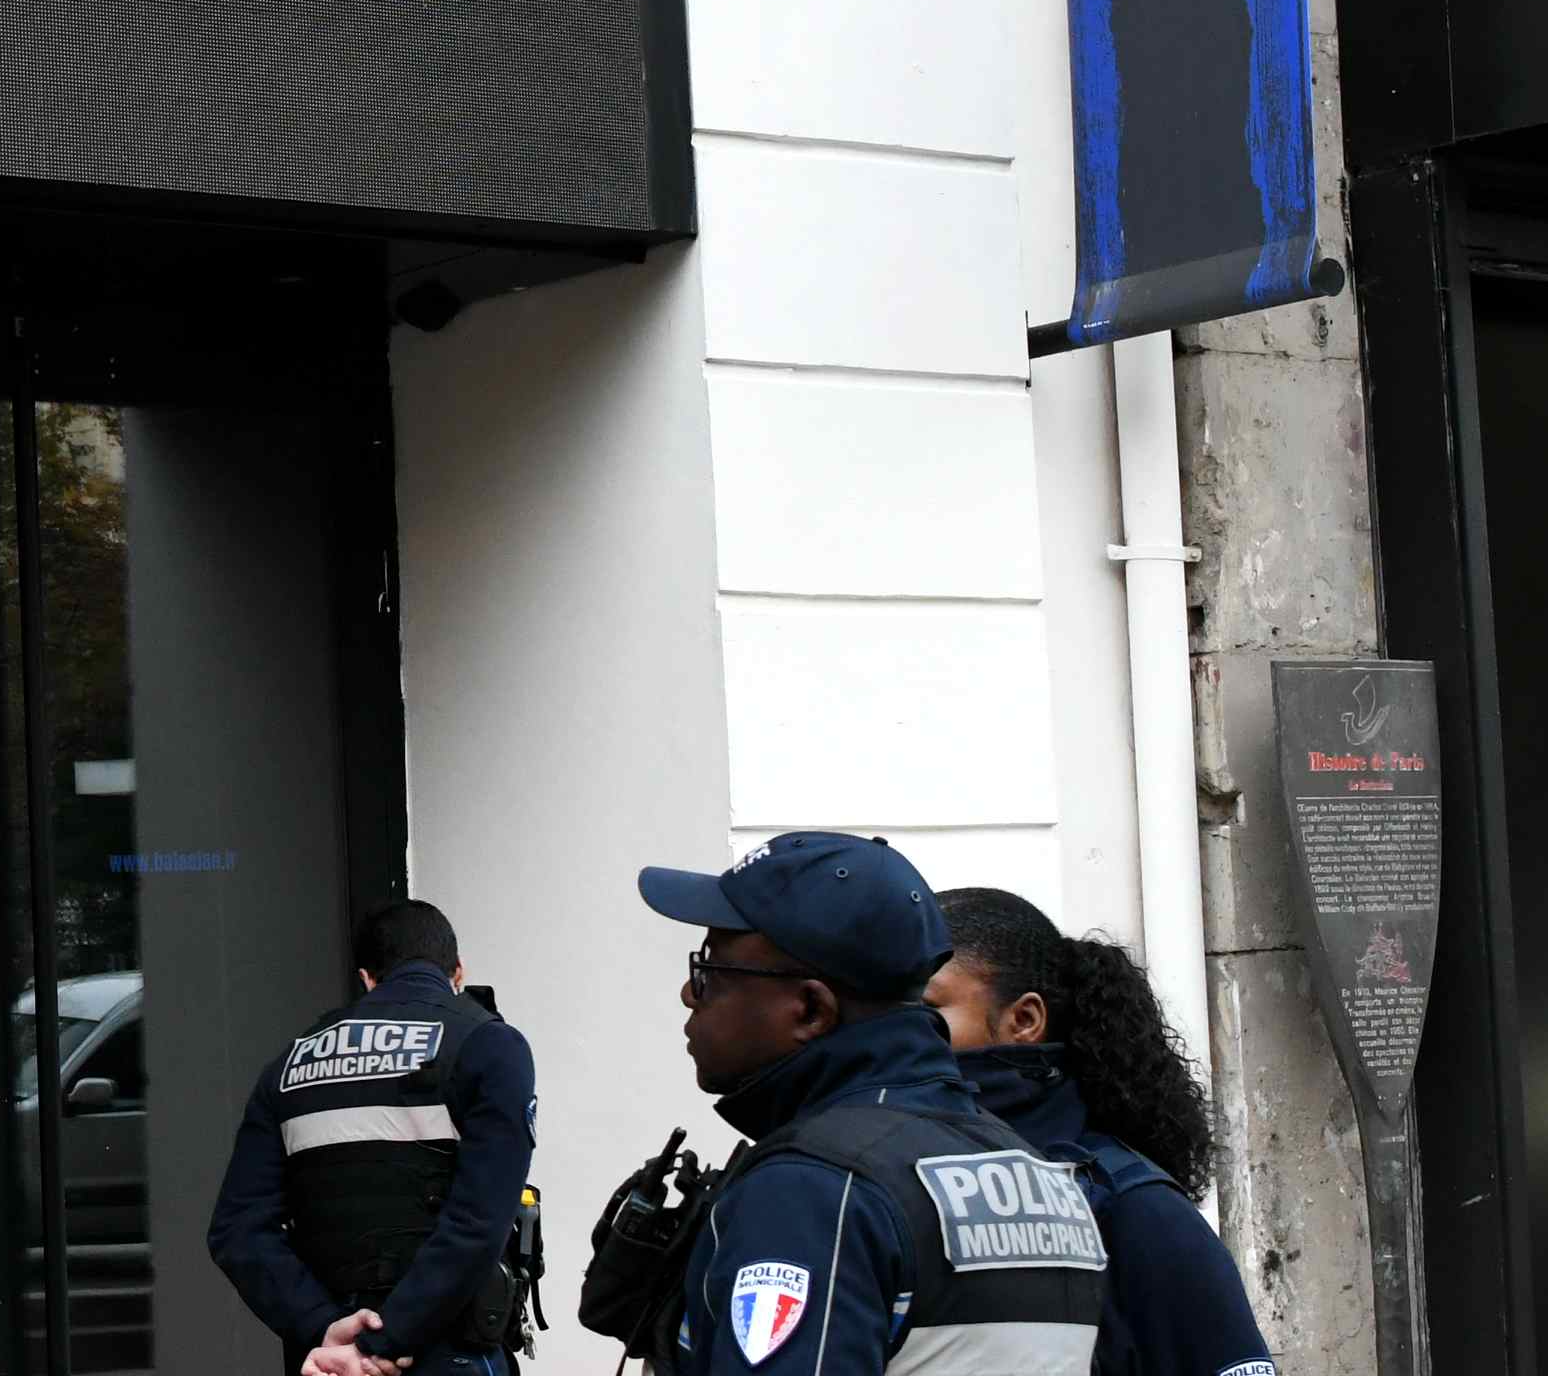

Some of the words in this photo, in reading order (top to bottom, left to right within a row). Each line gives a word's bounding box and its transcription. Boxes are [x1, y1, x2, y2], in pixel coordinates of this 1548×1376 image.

[294, 1025, 432, 1065] POLICE
[288, 1052, 426, 1084] MUNICIPALE
[935, 1162, 1088, 1220] POLICE
[957, 1223, 1097, 1259] MUNICIPALE
[738, 1279, 803, 1293] MUNICIPALE
[740, 1267, 806, 1284] POLICE
